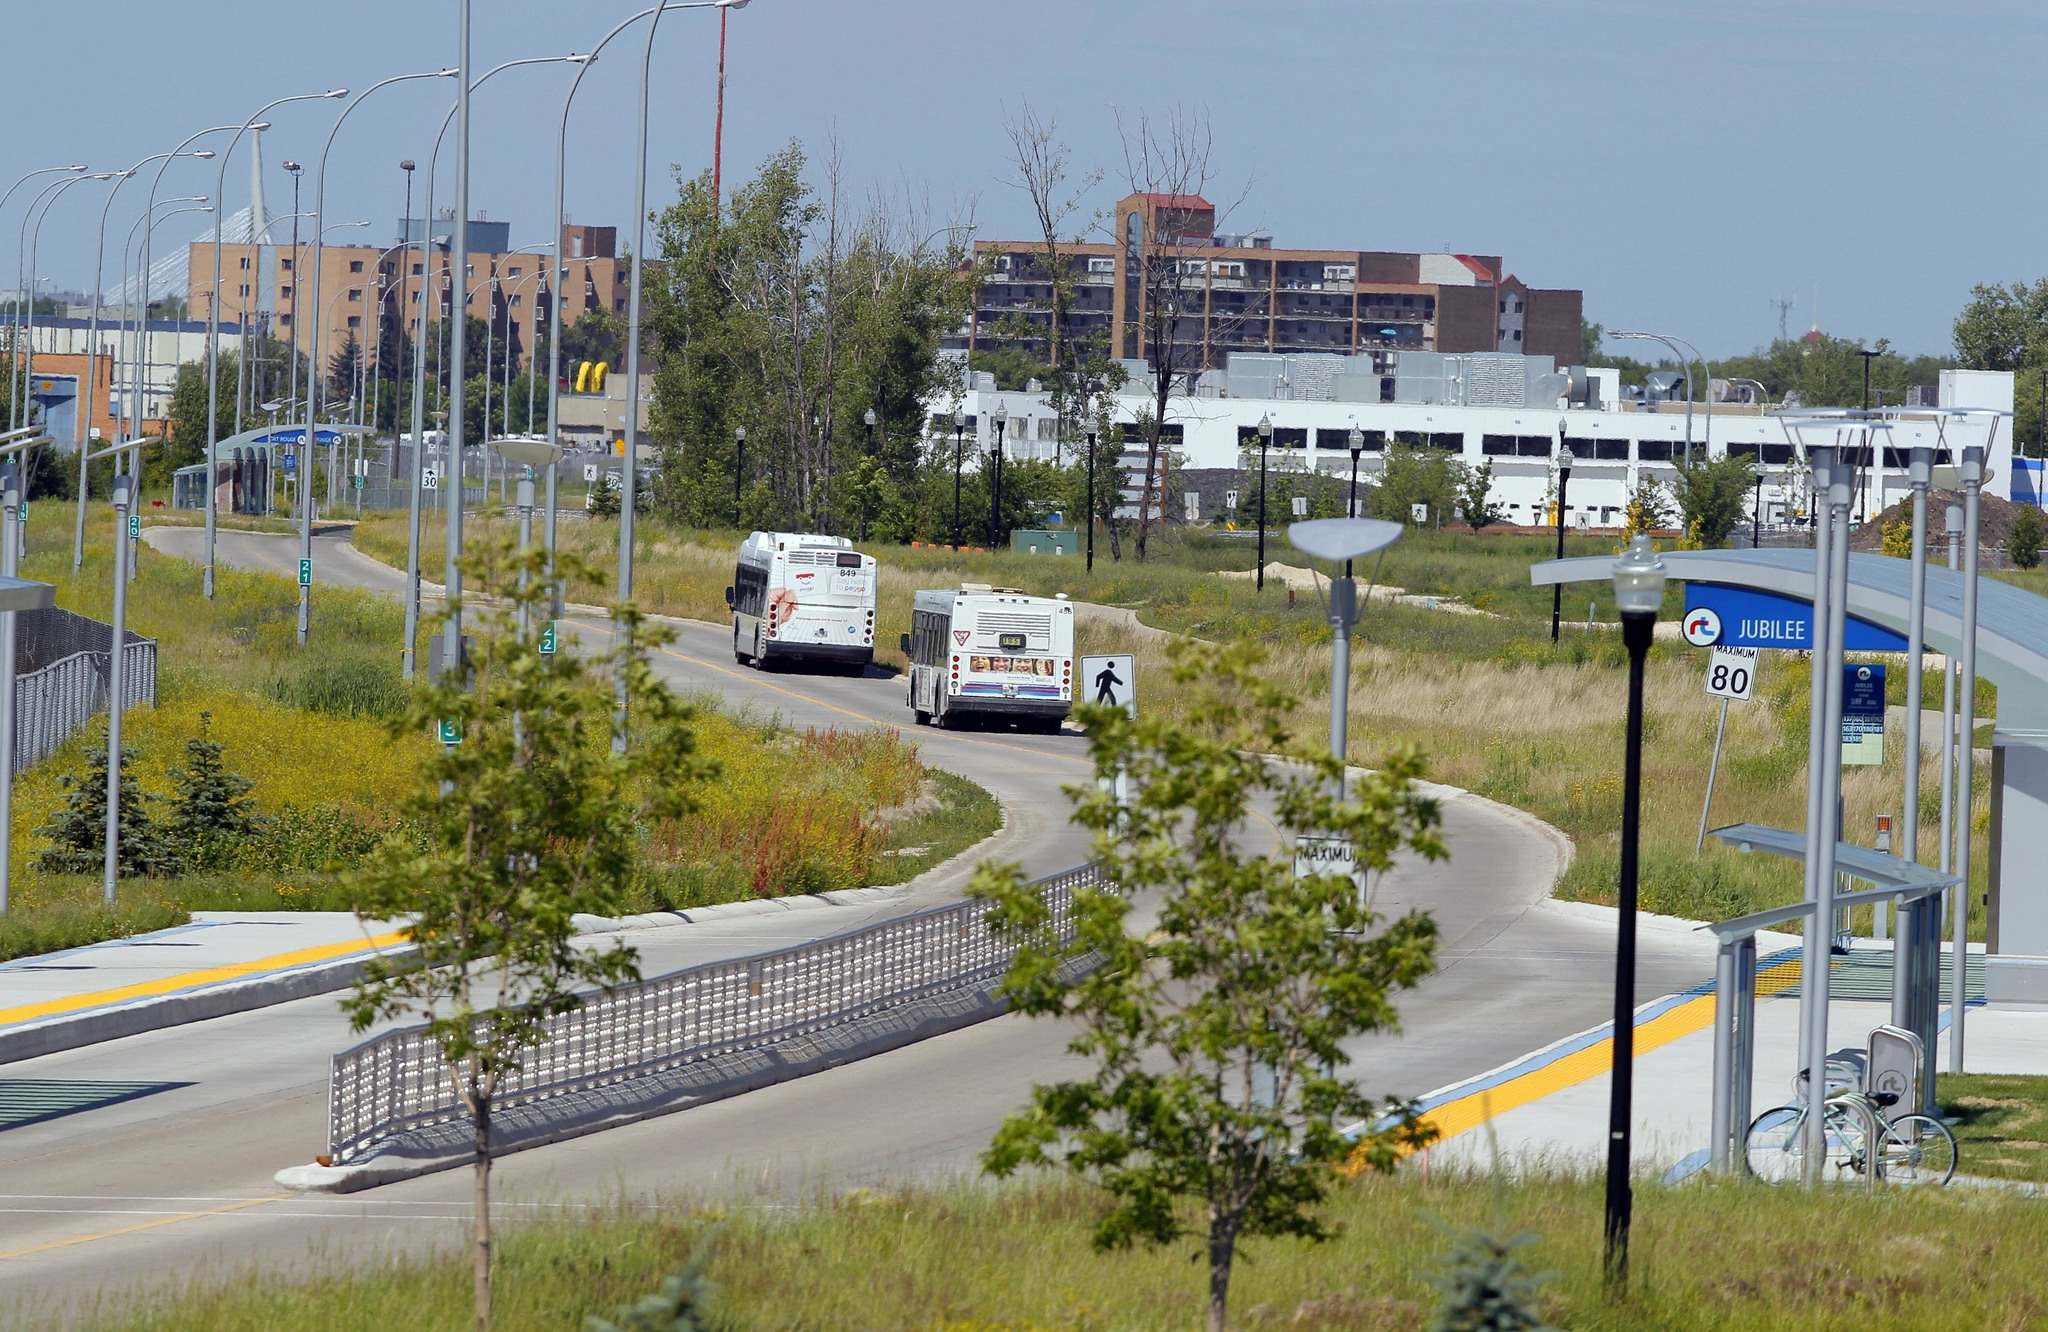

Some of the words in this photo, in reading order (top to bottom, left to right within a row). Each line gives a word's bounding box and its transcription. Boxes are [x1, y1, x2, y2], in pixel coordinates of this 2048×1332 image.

[423, 476, 437, 487] 30
[130, 519, 138, 536] 20
[302, 561, 309, 582] 21
[840, 569, 856, 577] 849
[1738, 619, 1805, 640] JUBILEE
[1715, 646, 1755, 659] MAXIMUM
[1711, 665, 1749, 694] 80
[1299, 847, 1359, 862] MAXIMU
